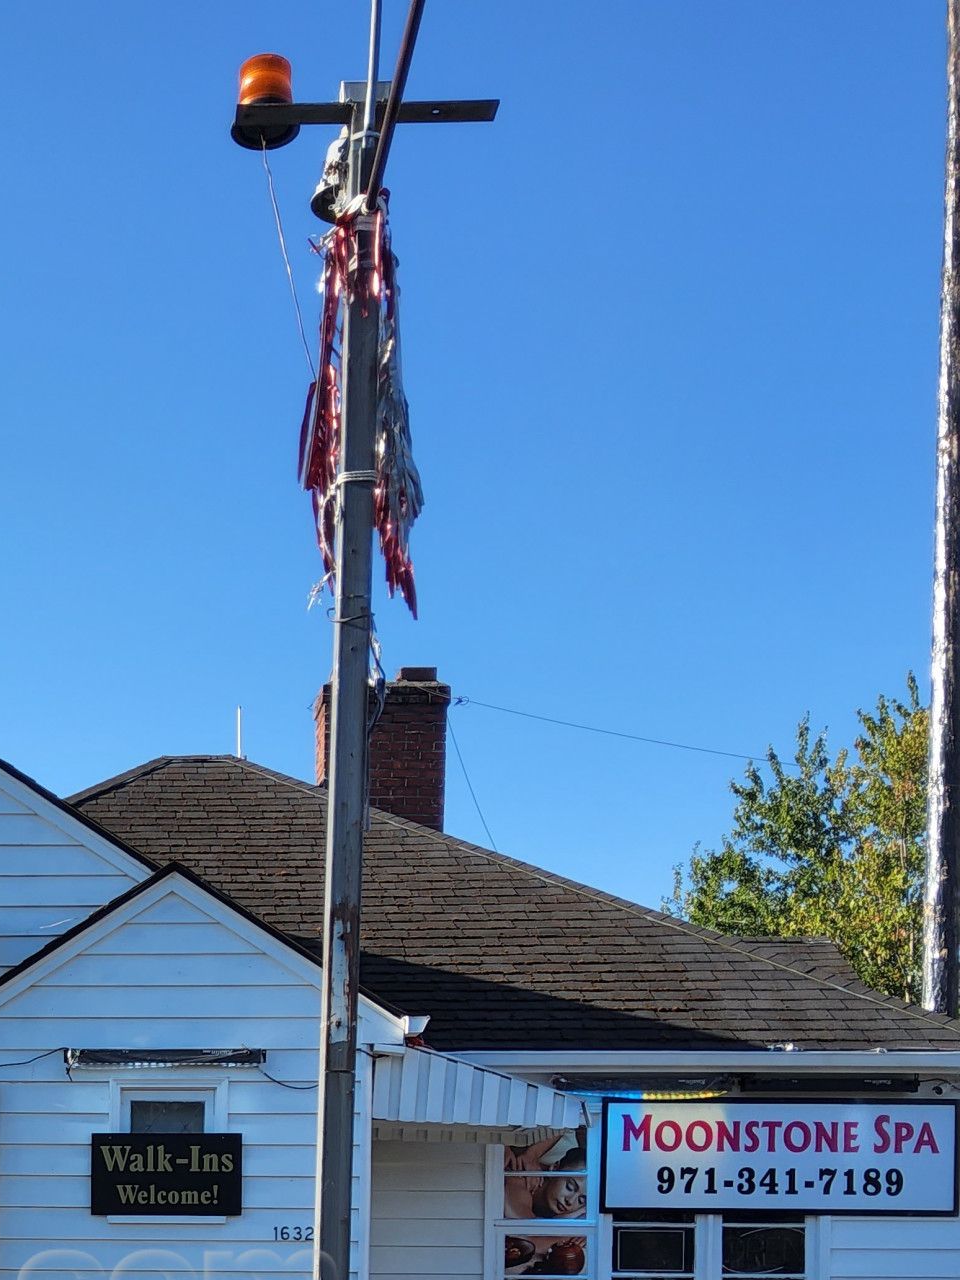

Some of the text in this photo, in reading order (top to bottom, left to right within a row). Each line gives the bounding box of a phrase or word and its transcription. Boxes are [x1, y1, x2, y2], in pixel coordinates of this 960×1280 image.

[621, 1114, 940, 1154] MOONSTONE SPA
[100, 1145, 234, 1172] Walk-Ins
[116, 1184, 219, 1205] Welcome!
[657, 1166, 904, 1196] 971-341-7189
